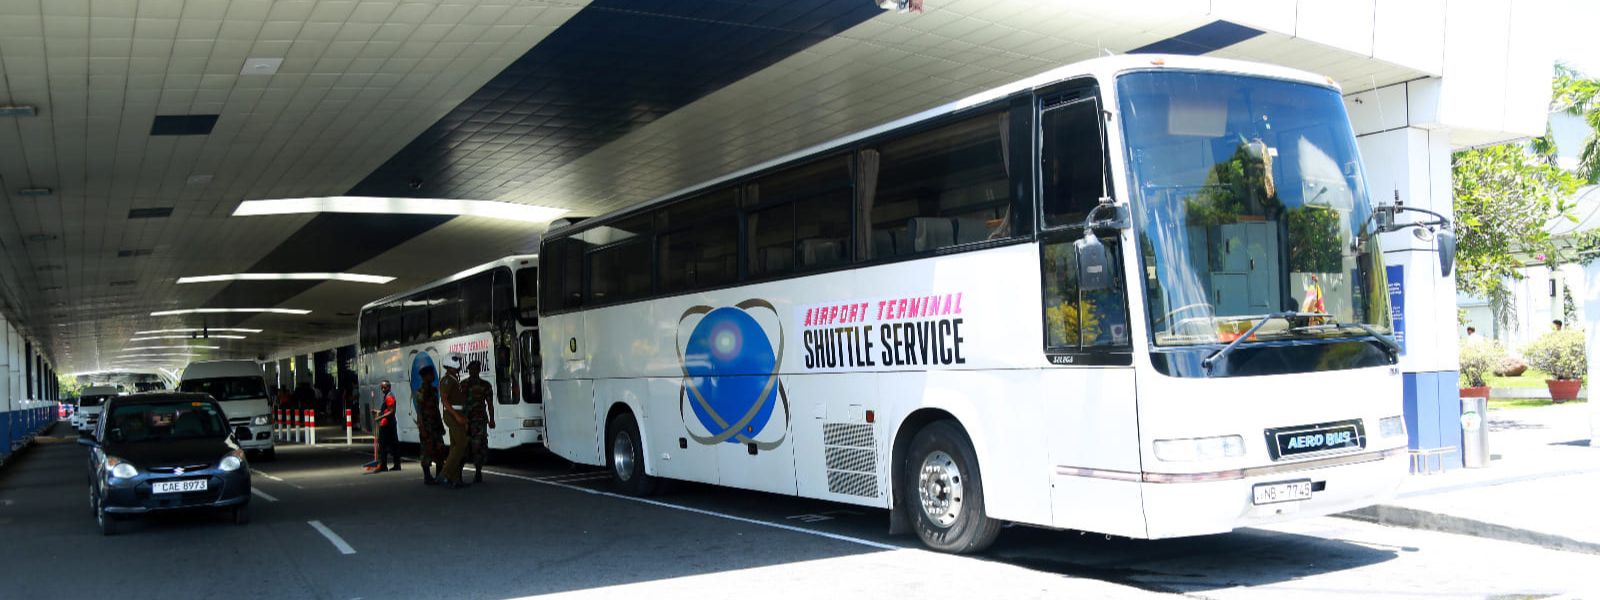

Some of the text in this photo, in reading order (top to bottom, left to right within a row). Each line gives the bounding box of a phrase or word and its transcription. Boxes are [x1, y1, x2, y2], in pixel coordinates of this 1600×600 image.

[804, 292, 962, 327] AIRPORT TERMINAL
[803, 318, 966, 369] SHUTTLE SERVICE
[1288, 431, 1351, 449] AERO BUS
[162, 482, 180, 491] CAE
[183, 481, 206, 490] 8973
